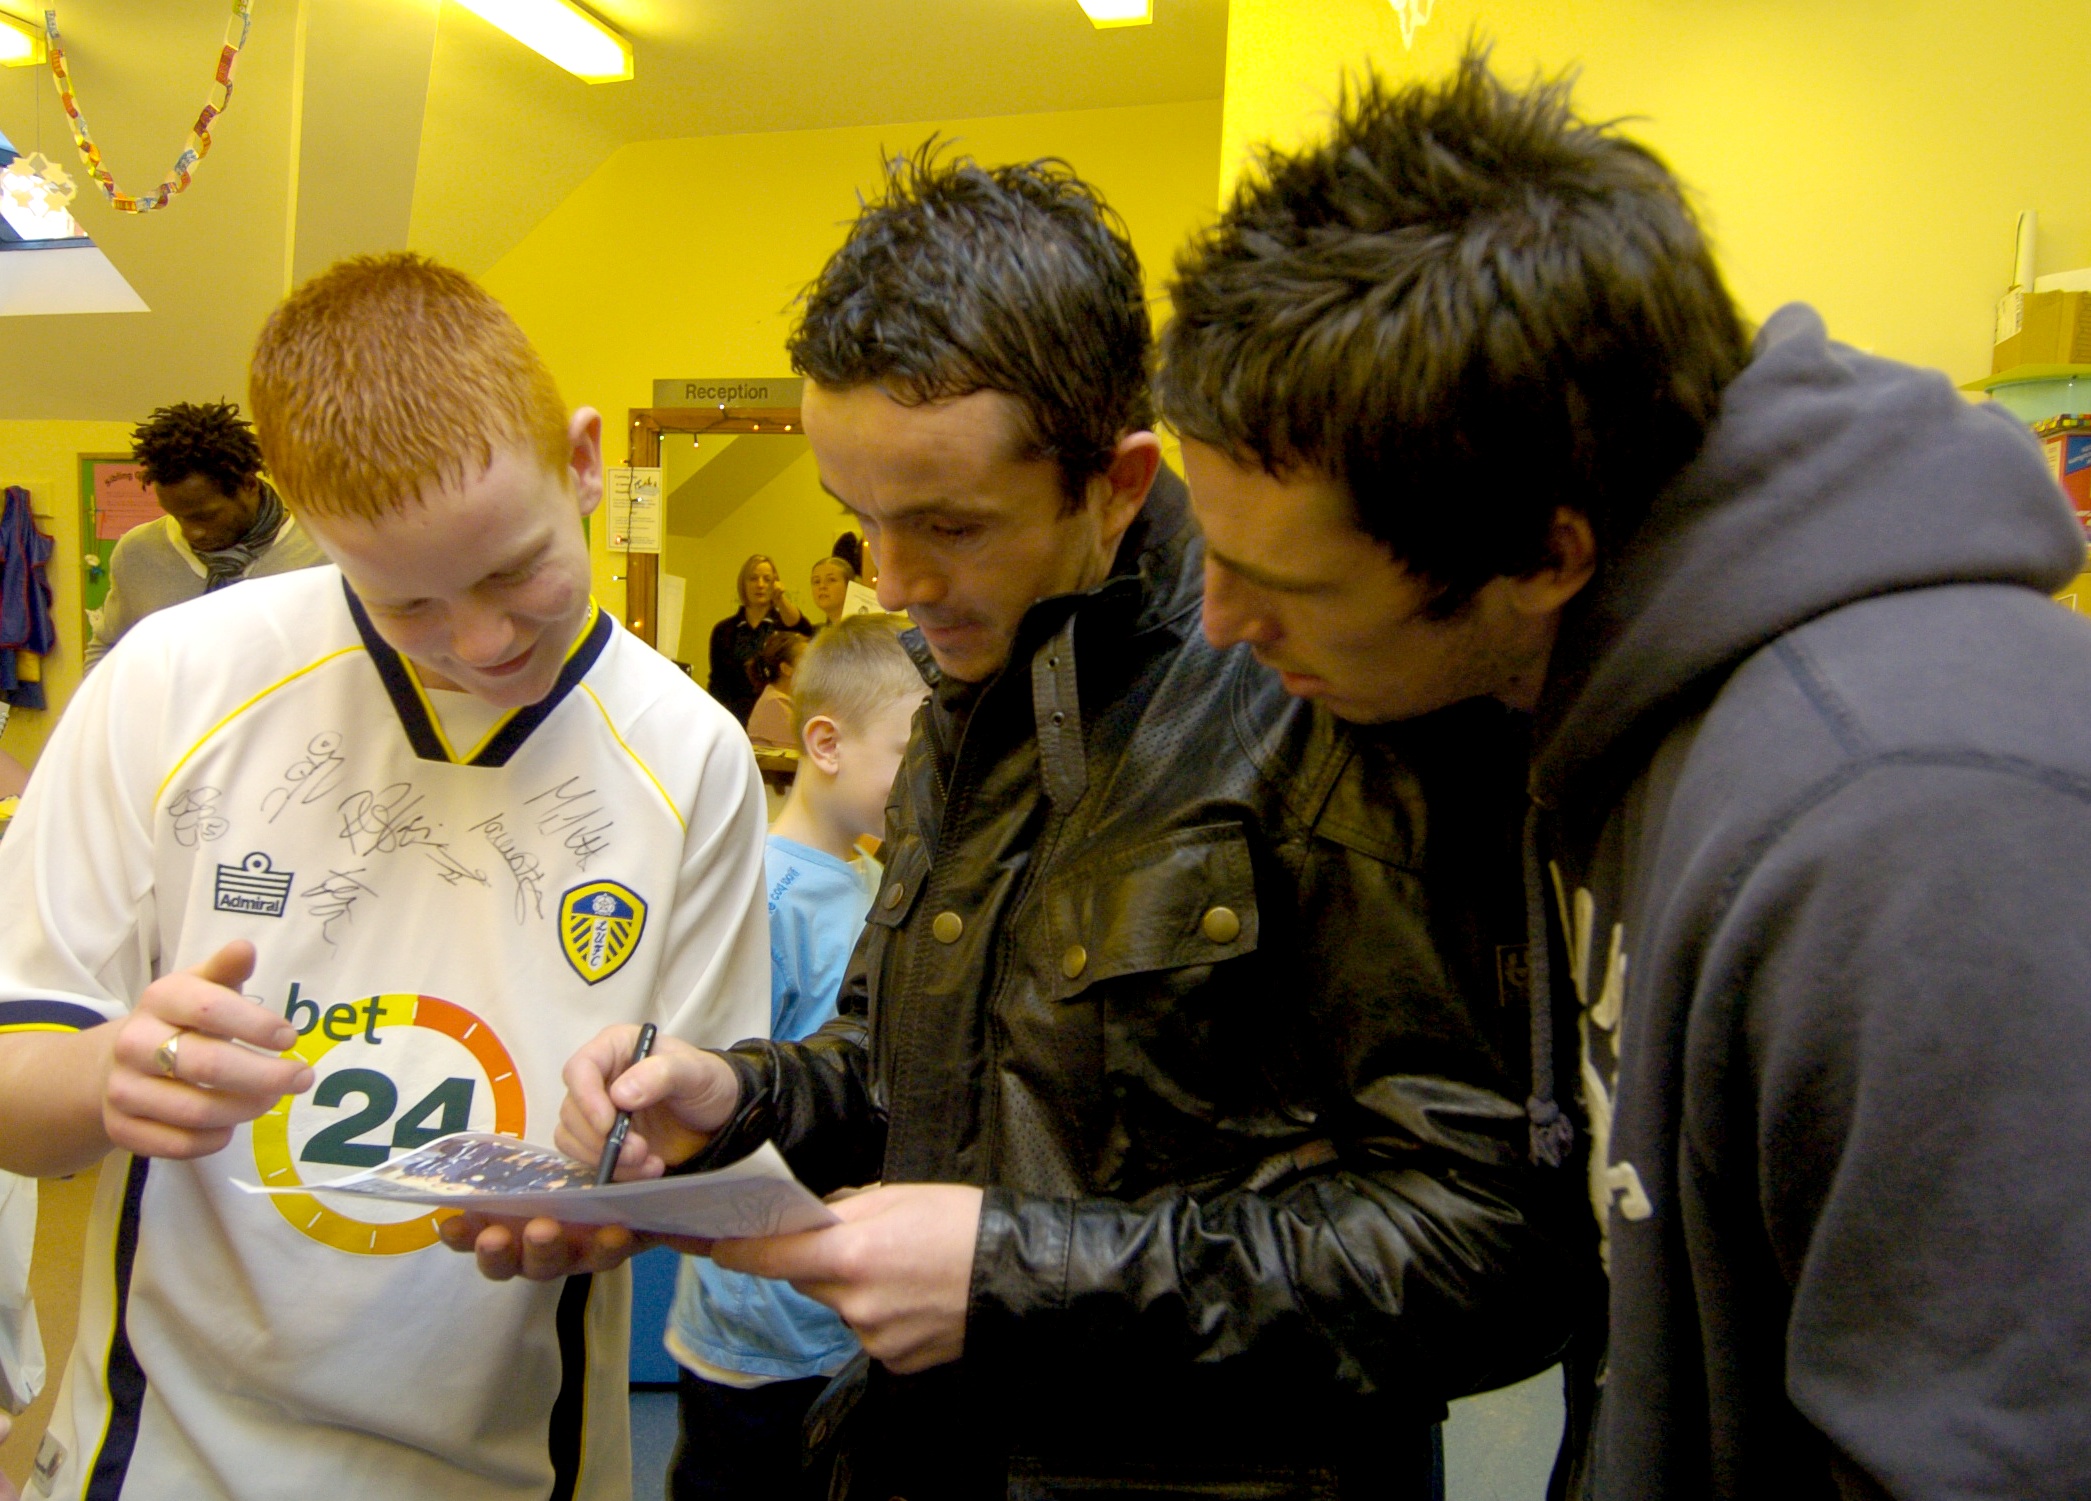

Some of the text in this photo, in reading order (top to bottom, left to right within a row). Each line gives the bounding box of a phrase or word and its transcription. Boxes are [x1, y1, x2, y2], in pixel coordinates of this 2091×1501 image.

[685, 383, 768, 402] Reception
[220, 893, 280, 912] Admiral
[283, 982, 387, 1045] bet
[300, 1067, 476, 1168] 24
